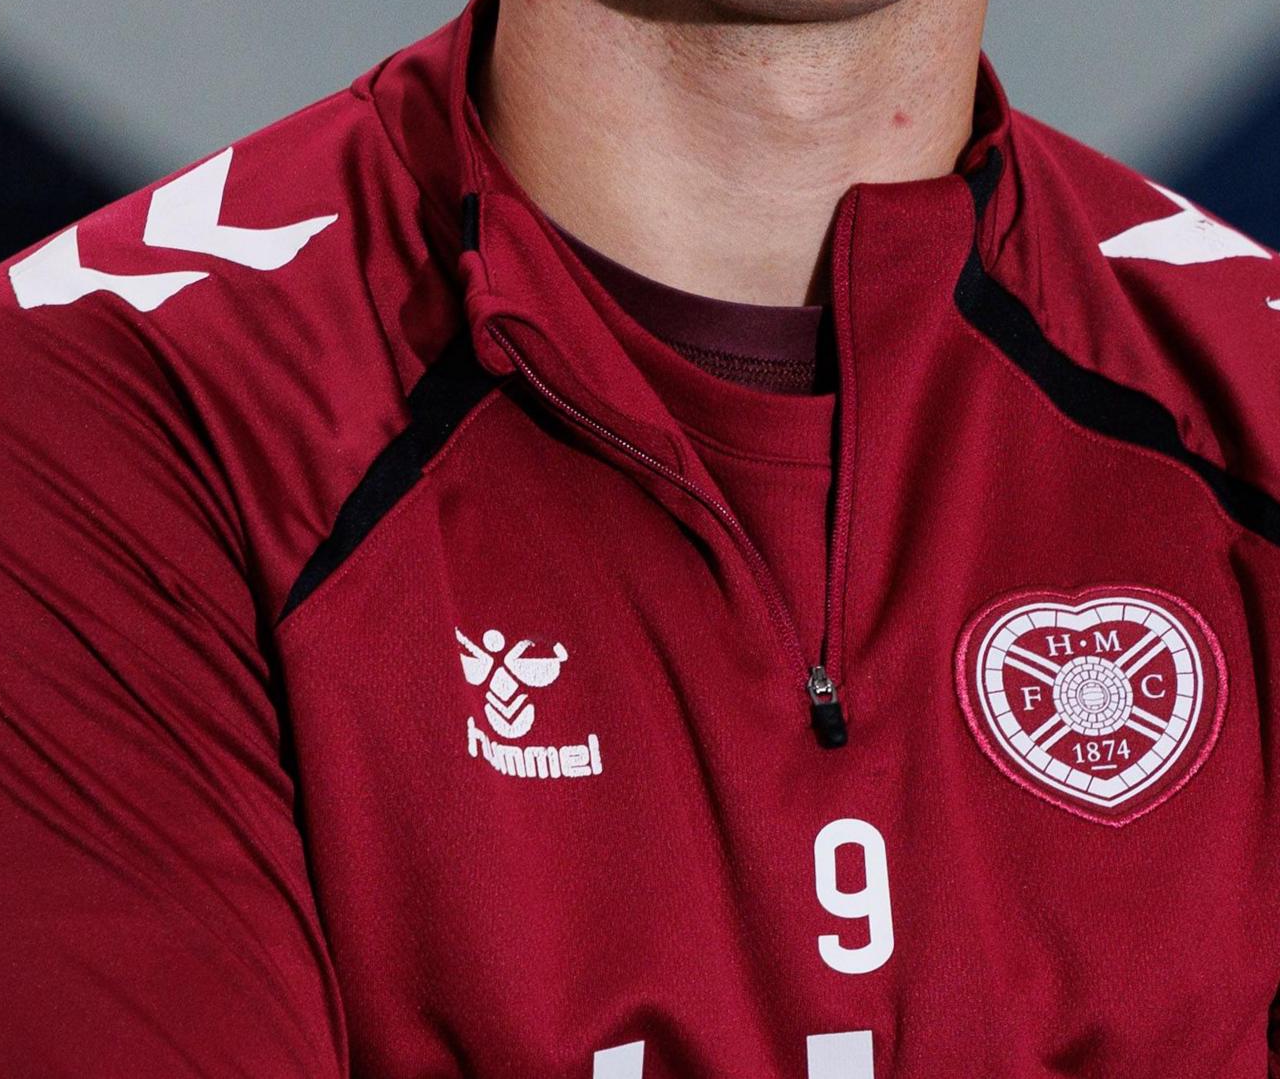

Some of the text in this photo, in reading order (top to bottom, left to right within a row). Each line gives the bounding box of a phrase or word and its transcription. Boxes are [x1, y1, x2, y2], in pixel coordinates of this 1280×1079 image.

[1021, 686, 1042, 710] F
[1141, 674, 1166, 699] C
[467, 716, 603, 779] hummel
[1072, 739, 1131, 764] 1874
[814, 818, 894, 973] 9
